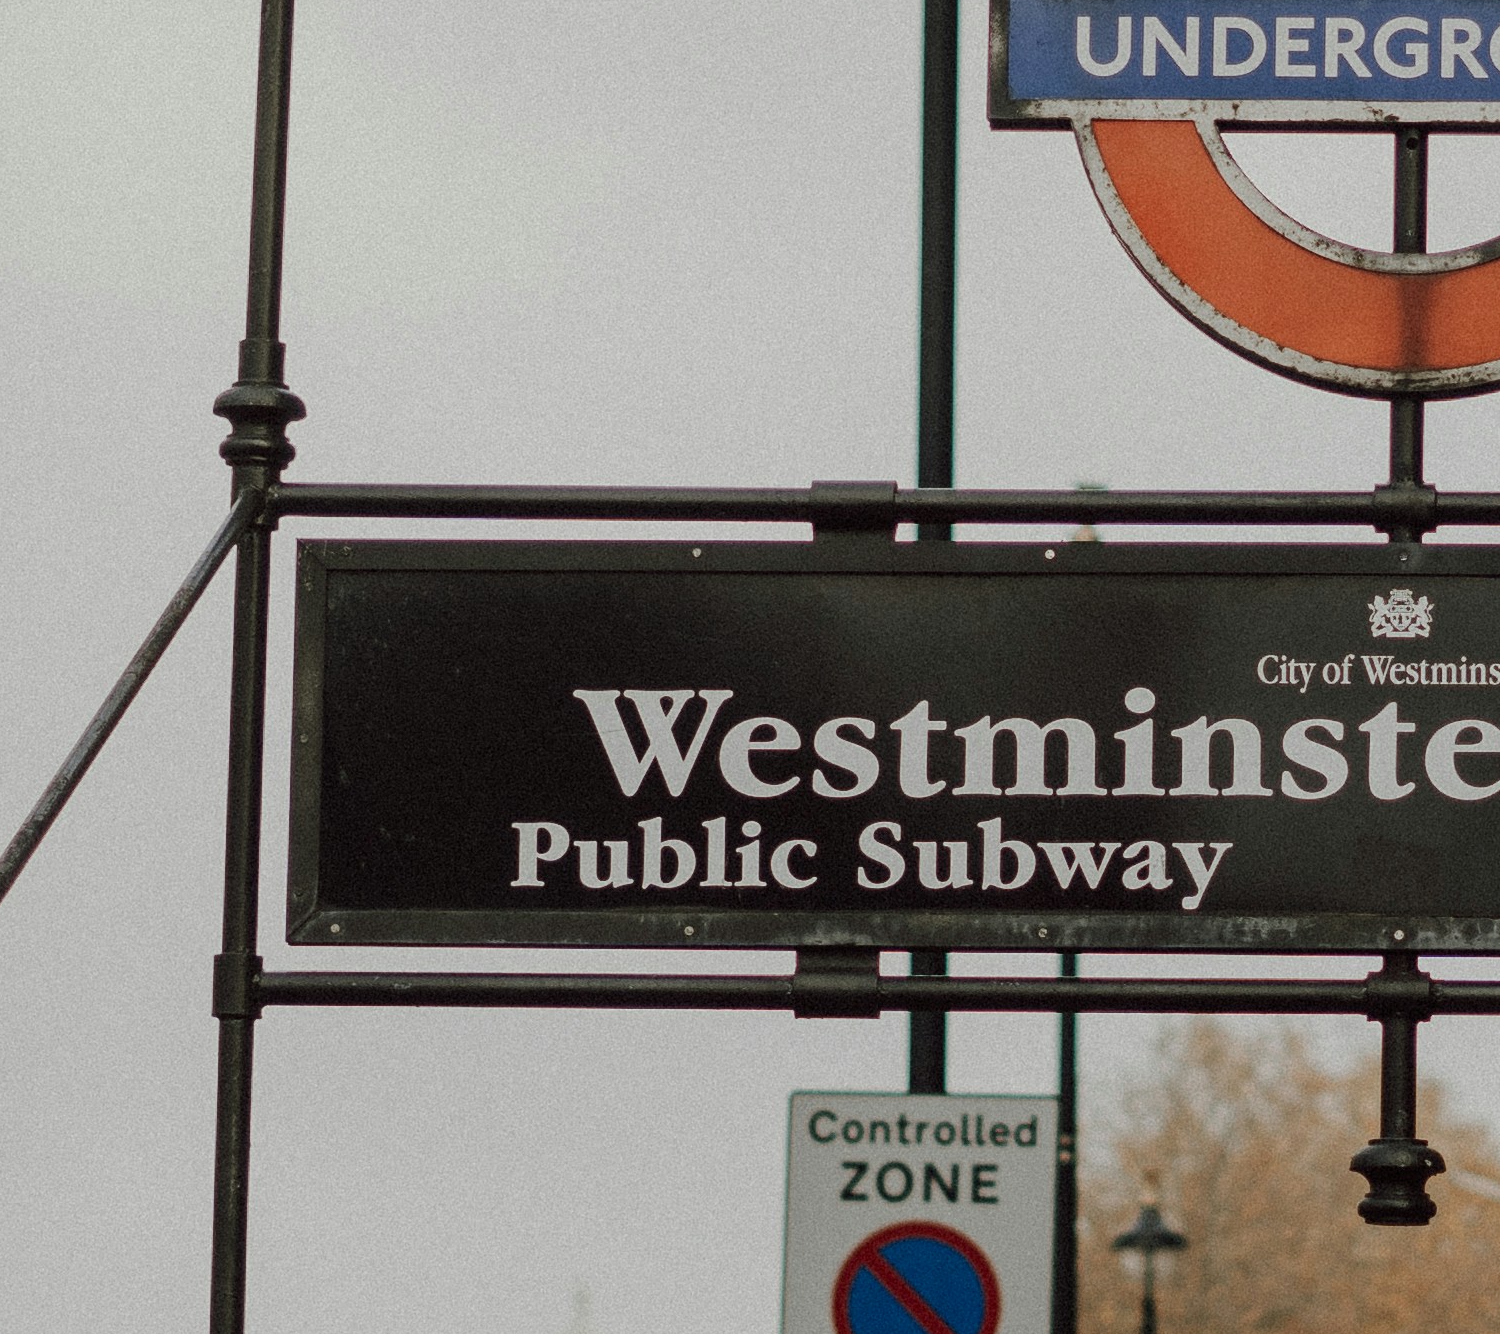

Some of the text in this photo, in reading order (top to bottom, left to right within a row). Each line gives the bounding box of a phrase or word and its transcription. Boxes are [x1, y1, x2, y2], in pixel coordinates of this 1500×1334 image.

[1256, 654, 1316, 694] City
[1321, 653, 1356, 685] of
[510, 816, 1234, 911] Public Subway
[807, 1109, 1038, 1148] Controlled
[840, 1161, 998, 1205] ZONE
